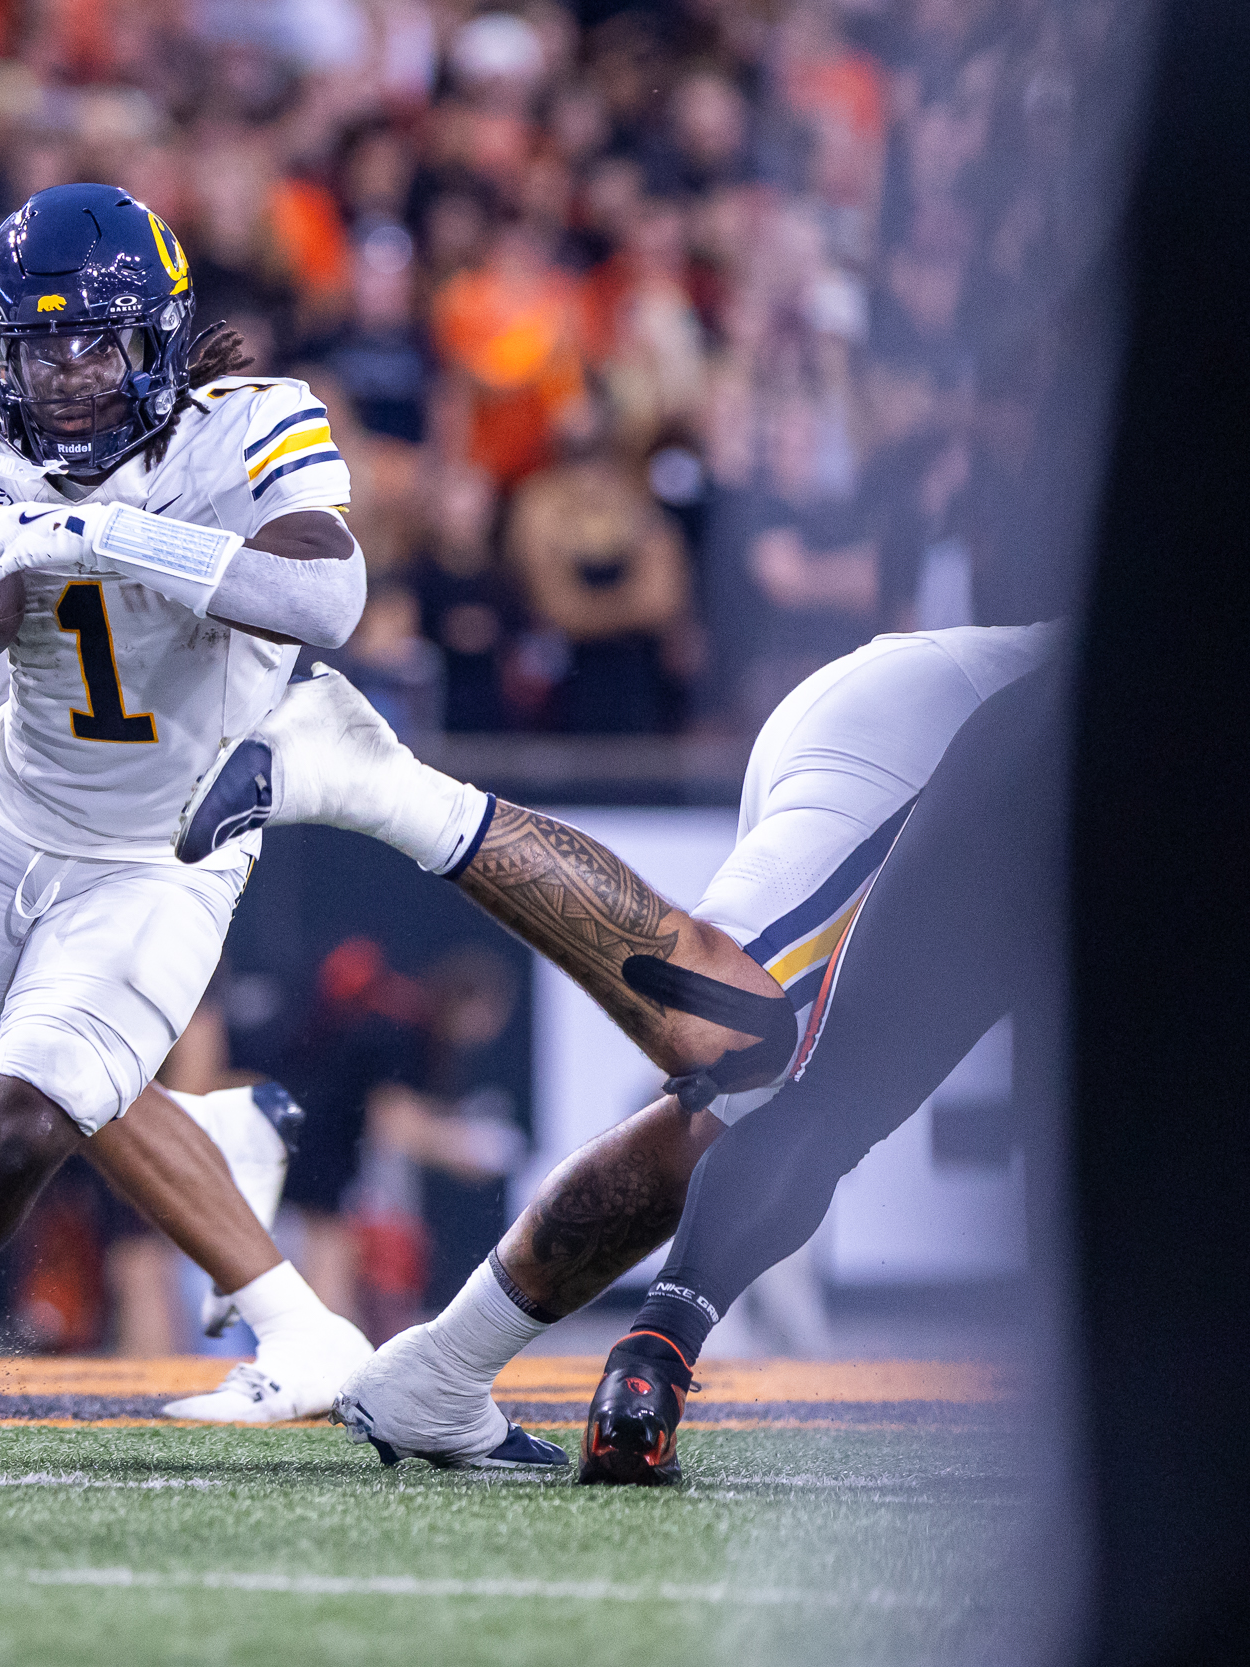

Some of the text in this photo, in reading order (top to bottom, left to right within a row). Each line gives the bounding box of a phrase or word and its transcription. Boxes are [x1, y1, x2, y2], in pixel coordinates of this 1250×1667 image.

[109, 304, 143, 313] OAKLEY
[55, 579, 159, 744] 1
[656, 1282, 696, 1299] NIKE
